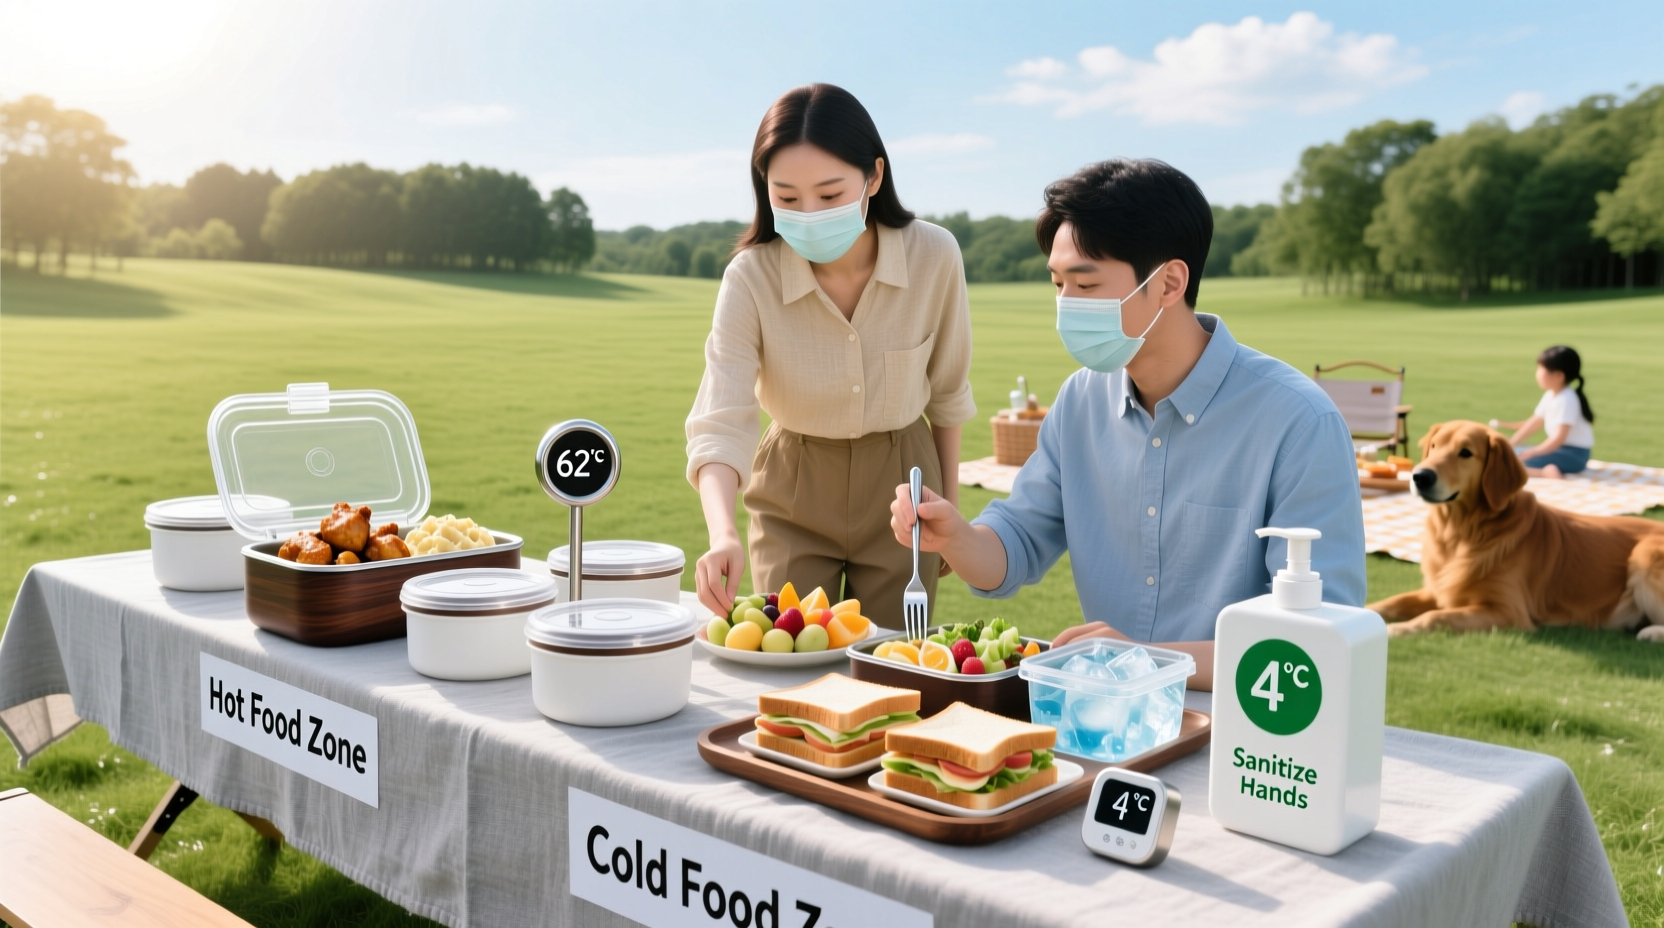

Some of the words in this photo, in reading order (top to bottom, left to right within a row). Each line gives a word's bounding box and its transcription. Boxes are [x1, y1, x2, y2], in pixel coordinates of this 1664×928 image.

[210, 676, 245, 723] Hot
[251, 692, 301, 747] Food
[308, 716, 367, 774] Zone
[1232, 747, 1318, 784] Sanitize
[1240, 775, 1309, 808] Hands
[586, 825, 667, 899] Cold
[681, 857, 779, 928] Food
